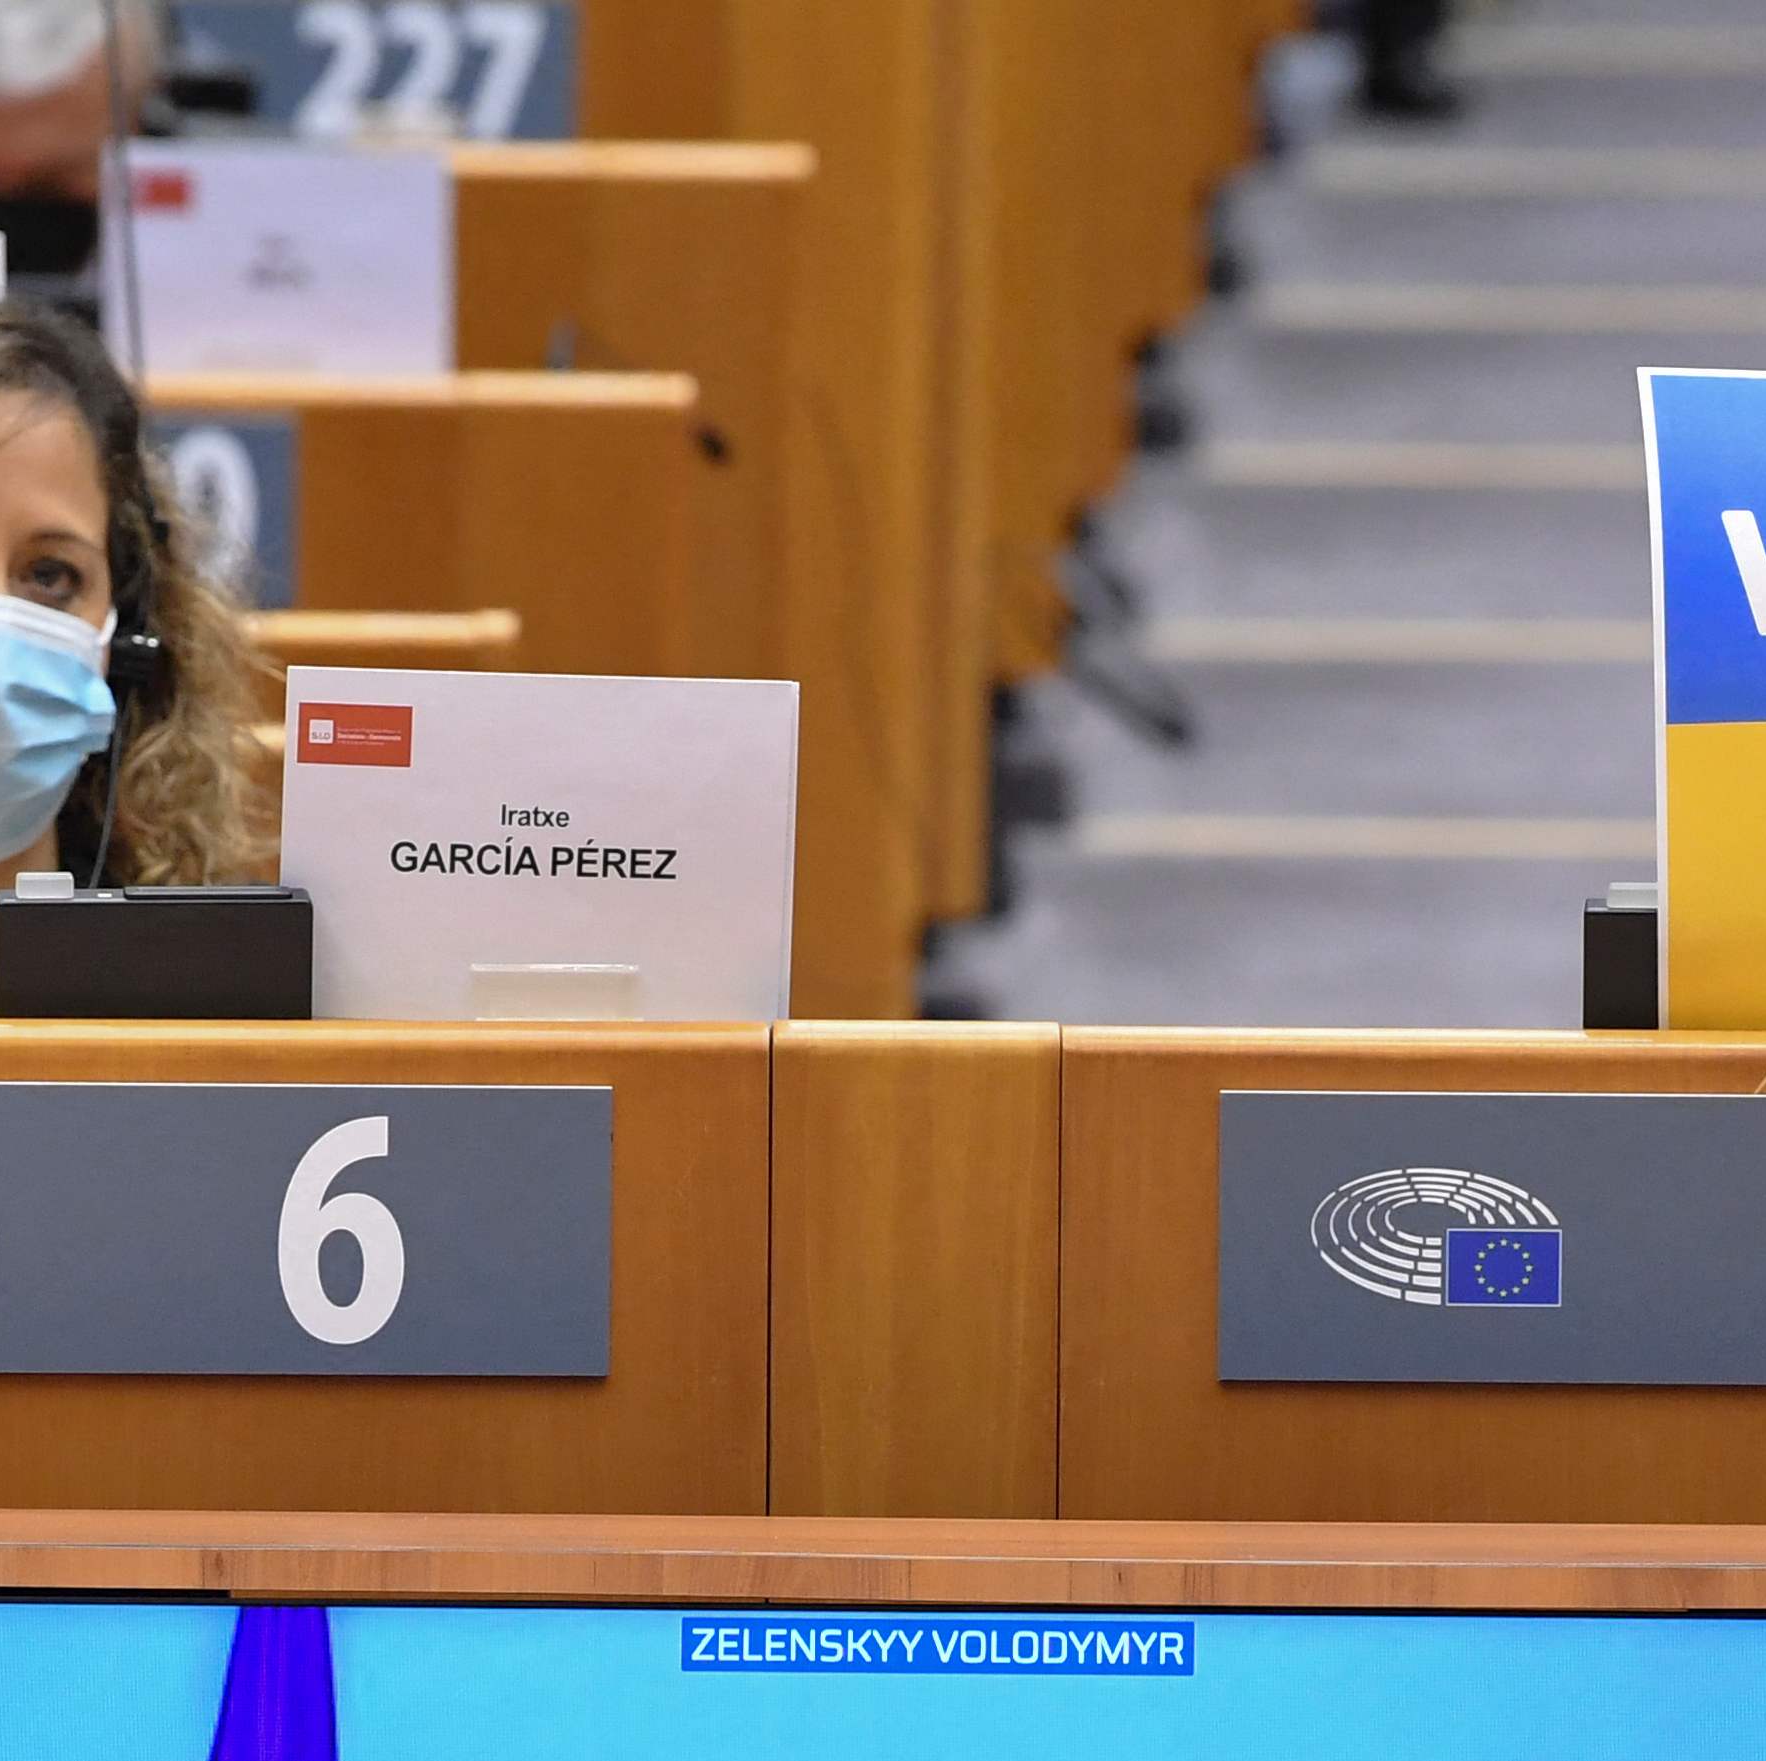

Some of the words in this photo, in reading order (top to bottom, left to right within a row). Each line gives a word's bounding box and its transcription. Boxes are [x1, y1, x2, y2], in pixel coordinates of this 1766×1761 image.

[292, 3, 545, 137] 227
[501, 803, 570, 828] Iratxe
[390, 836, 541, 877] GARCÍA
[550, 838, 678, 880] PÉREZ
[277, 1114, 406, 1345] 6
[690, 1627, 924, 1664] ZELENSKYY
[932, 1629, 1185, 1666] VOLODYMYR
